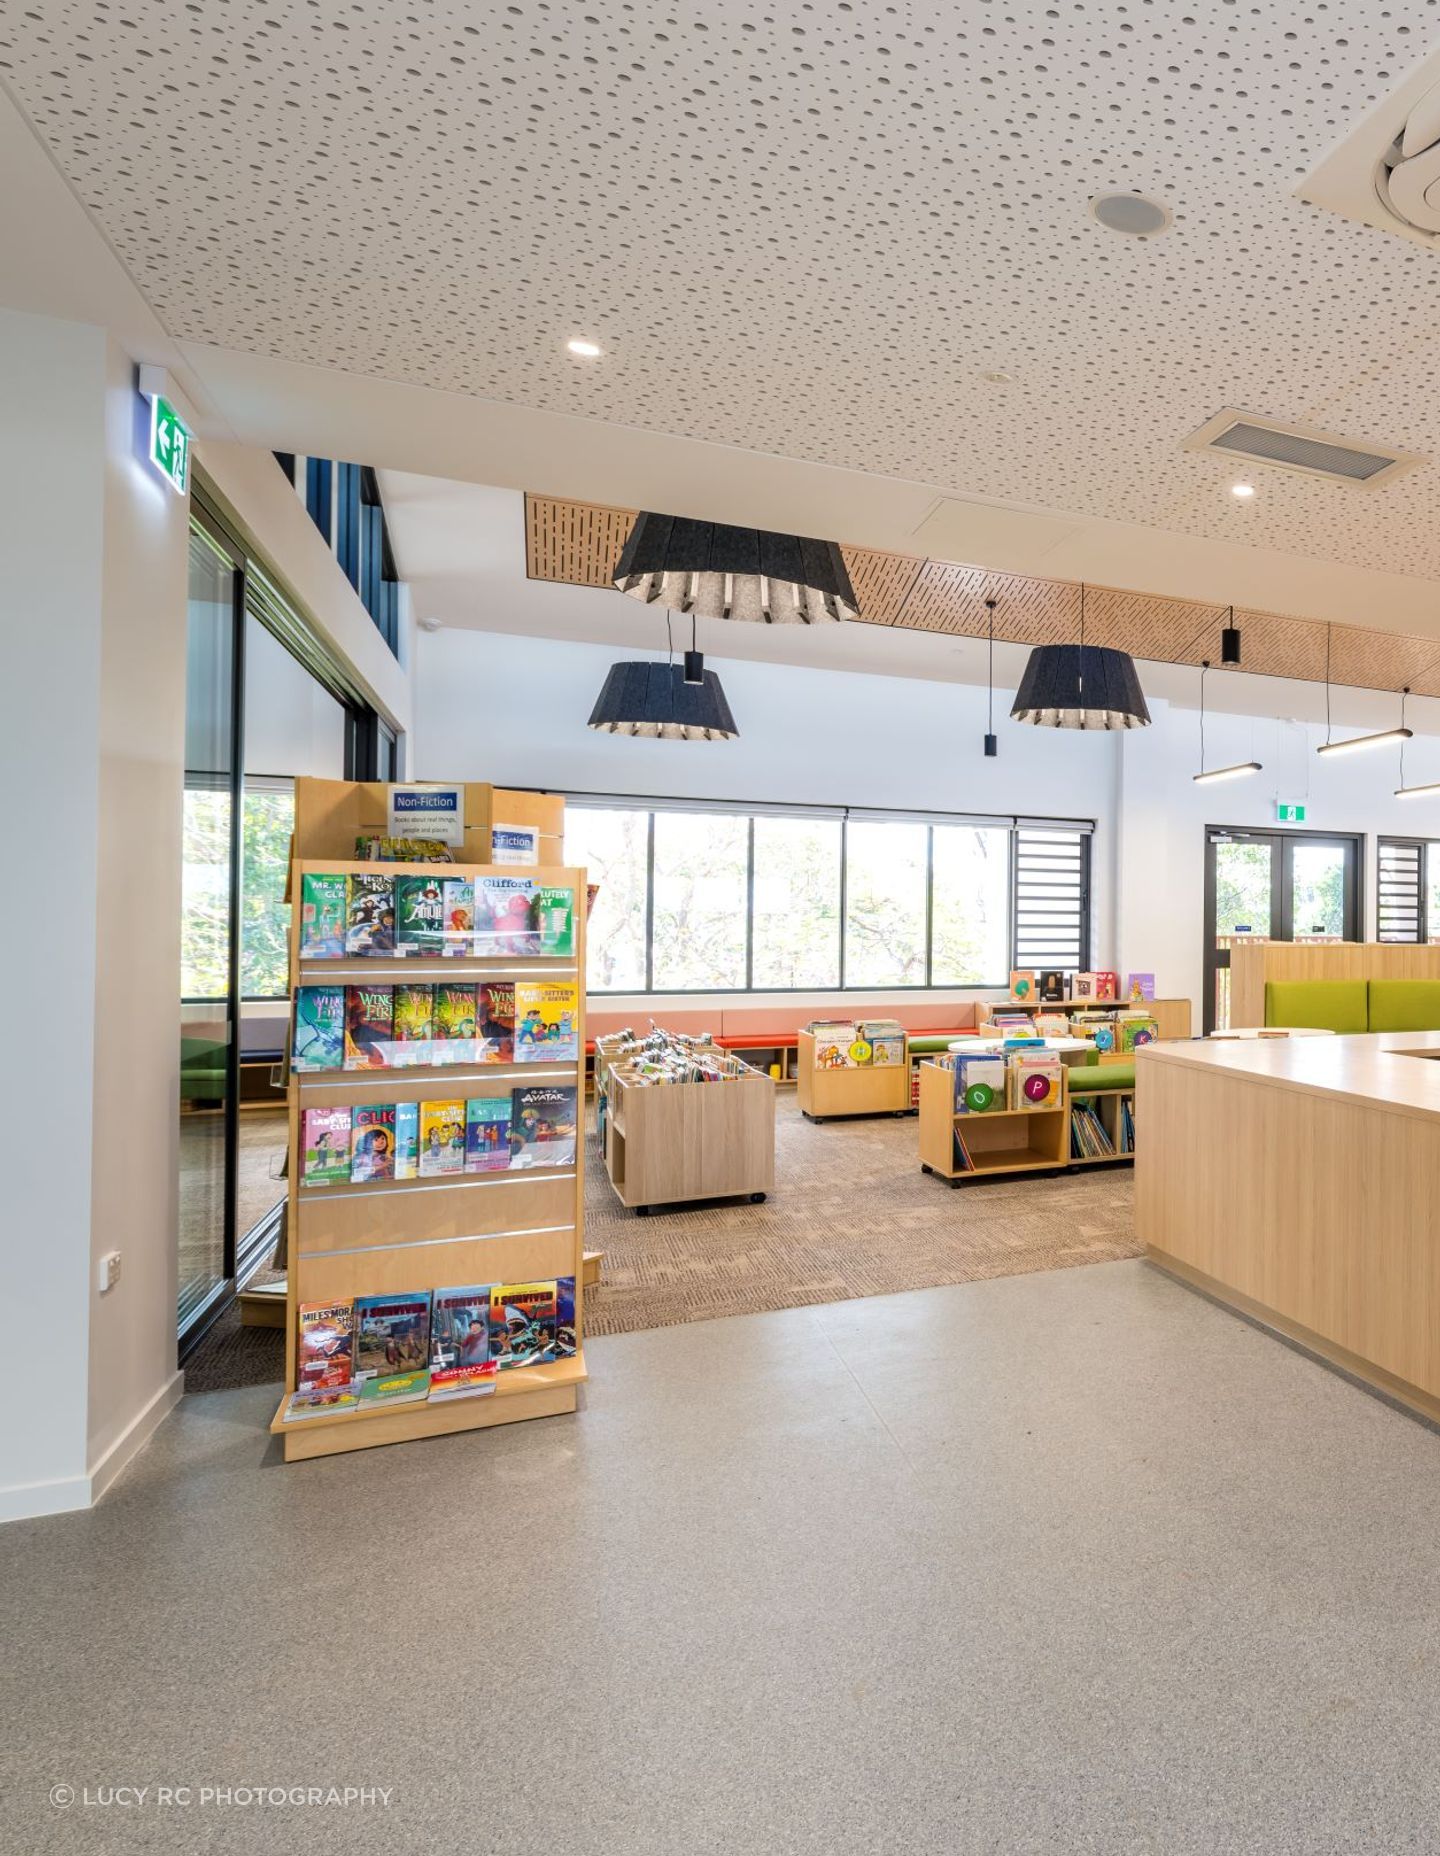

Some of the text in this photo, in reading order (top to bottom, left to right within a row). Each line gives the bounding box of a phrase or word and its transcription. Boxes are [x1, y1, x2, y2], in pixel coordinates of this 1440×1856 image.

[397, 796, 453, 807] Non-Fiction
[483, 878, 532, 888] Clifford
[1032, 1080, 1043, 1095] P
[521, 1093, 571, 1103] AVATAR
[501, 1291, 554, 1306] SURVIVED
[303, 1310, 330, 1322] MILES
